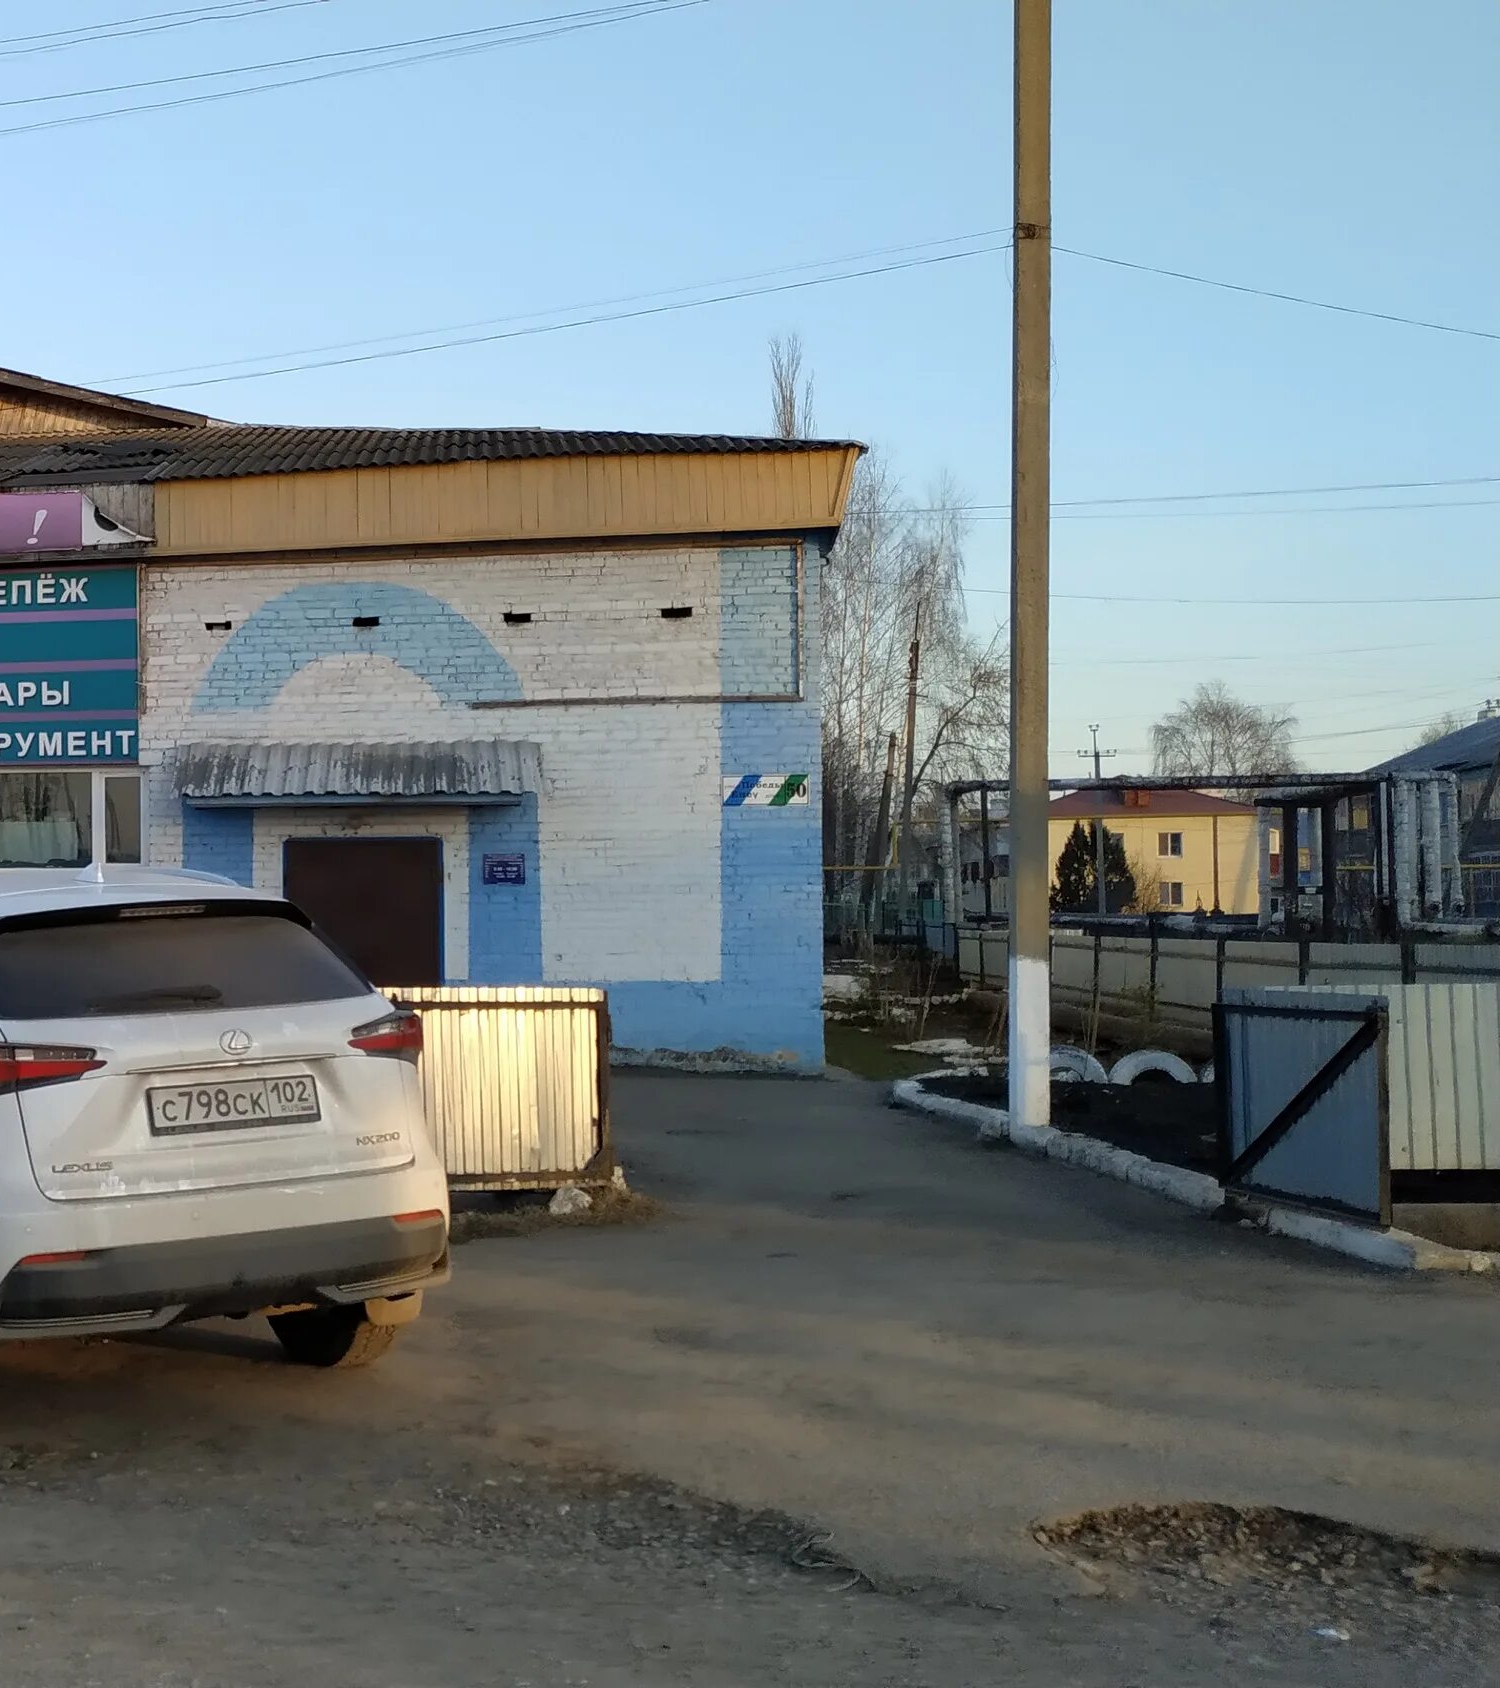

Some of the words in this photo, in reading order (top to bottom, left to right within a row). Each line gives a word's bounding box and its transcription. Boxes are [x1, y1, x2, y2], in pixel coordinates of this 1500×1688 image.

[786, 782, 807, 798] 50
[161, 1088, 266, 1122] С798СК
[270, 1081, 310, 1104] 102
[281, 1104, 300, 1113] RUS
[355, 1131, 400, 1146] NX200
[51, 1161, 113, 1174] LEXUS
